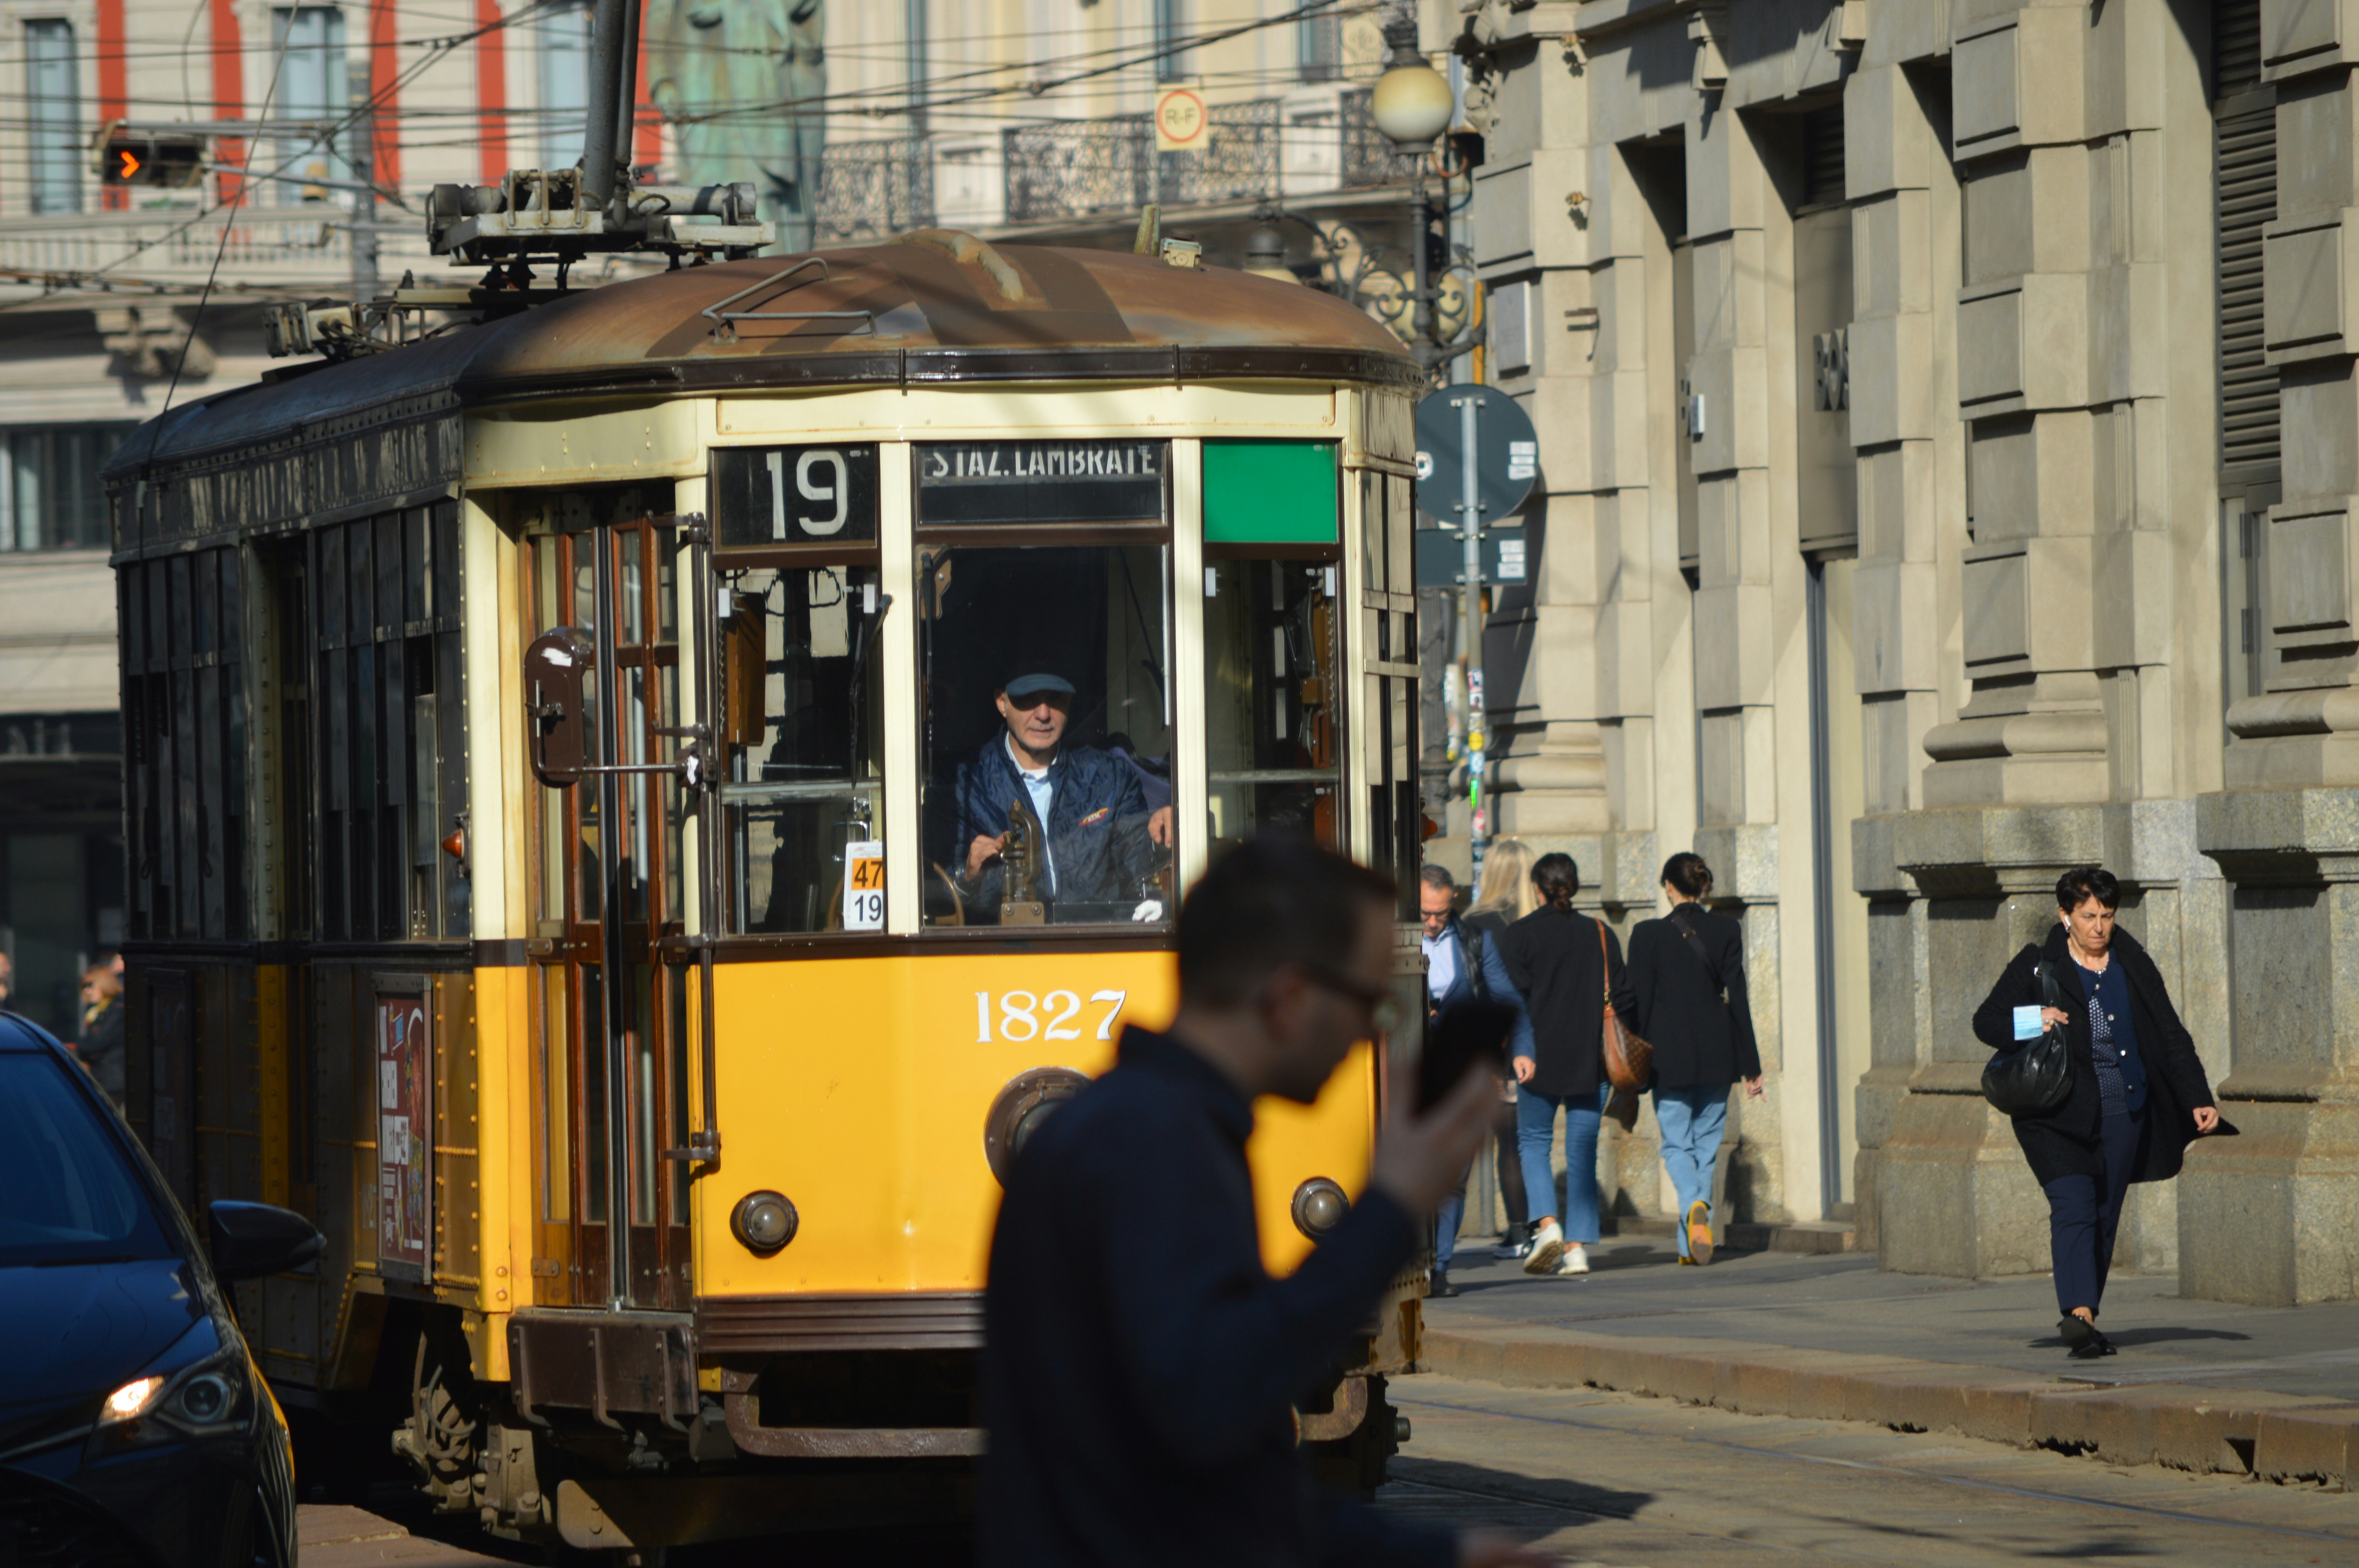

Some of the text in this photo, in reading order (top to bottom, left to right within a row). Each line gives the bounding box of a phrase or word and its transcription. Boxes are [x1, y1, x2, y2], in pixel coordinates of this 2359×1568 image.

[766, 450, 848, 539] 19
[854, 860, 883, 887] 47
[854, 894, 882, 922] 19
[975, 989, 1126, 1043] 1827
